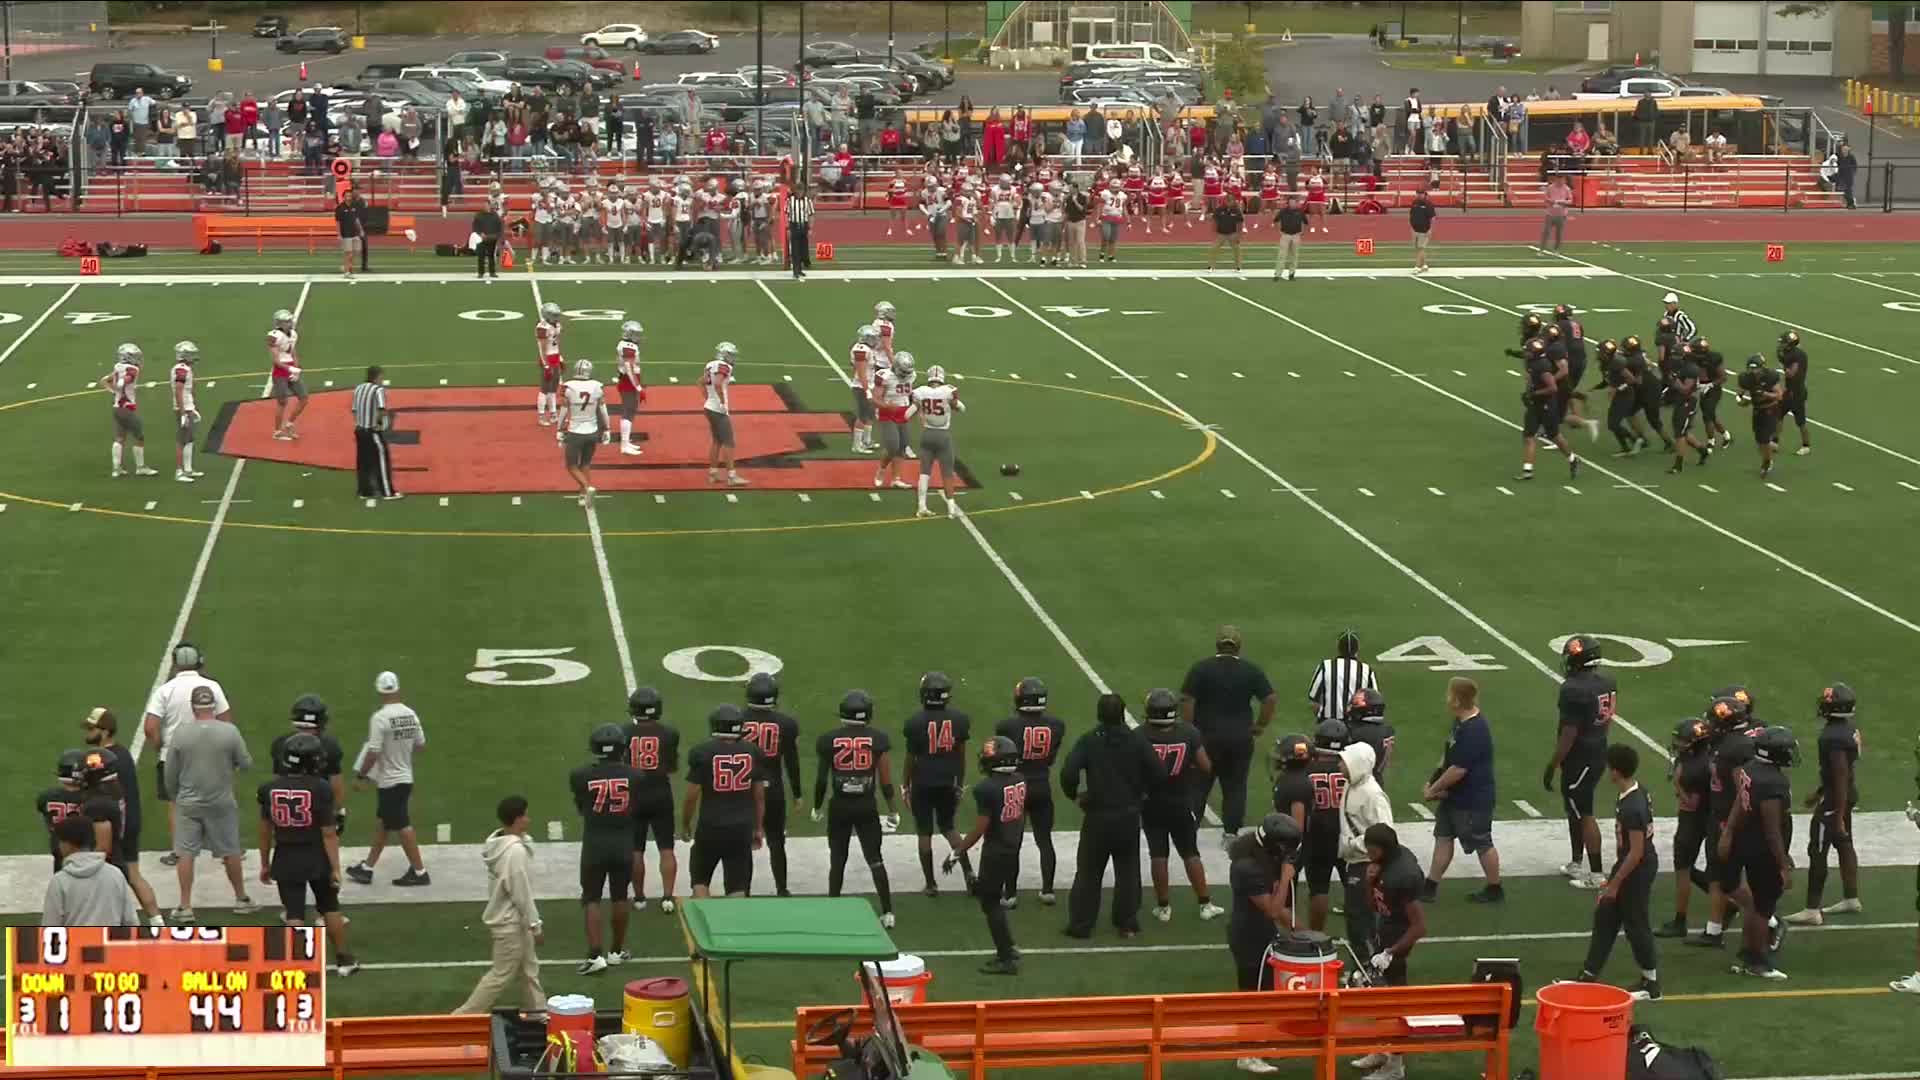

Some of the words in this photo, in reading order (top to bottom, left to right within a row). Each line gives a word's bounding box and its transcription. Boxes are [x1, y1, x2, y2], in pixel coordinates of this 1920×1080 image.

[82, 259, 97, 272] 40
[817, 244, 831, 257] 40
[1768, 247, 1781, 259] 20
[579, 391, 590, 411] 7
[922, 399, 945, 416] 85
[629, 736, 660, 770] 18
[742, 721, 780, 757] 20
[833, 736, 873, 771] 26
[927, 719, 955, 754] 14
[1023, 726, 1051, 760] 19
[712, 753, 753, 791] 62
[270, 789, 312, 827] 63
[588, 778, 630, 815] 75
[1287, 976, 1307, 991] G
